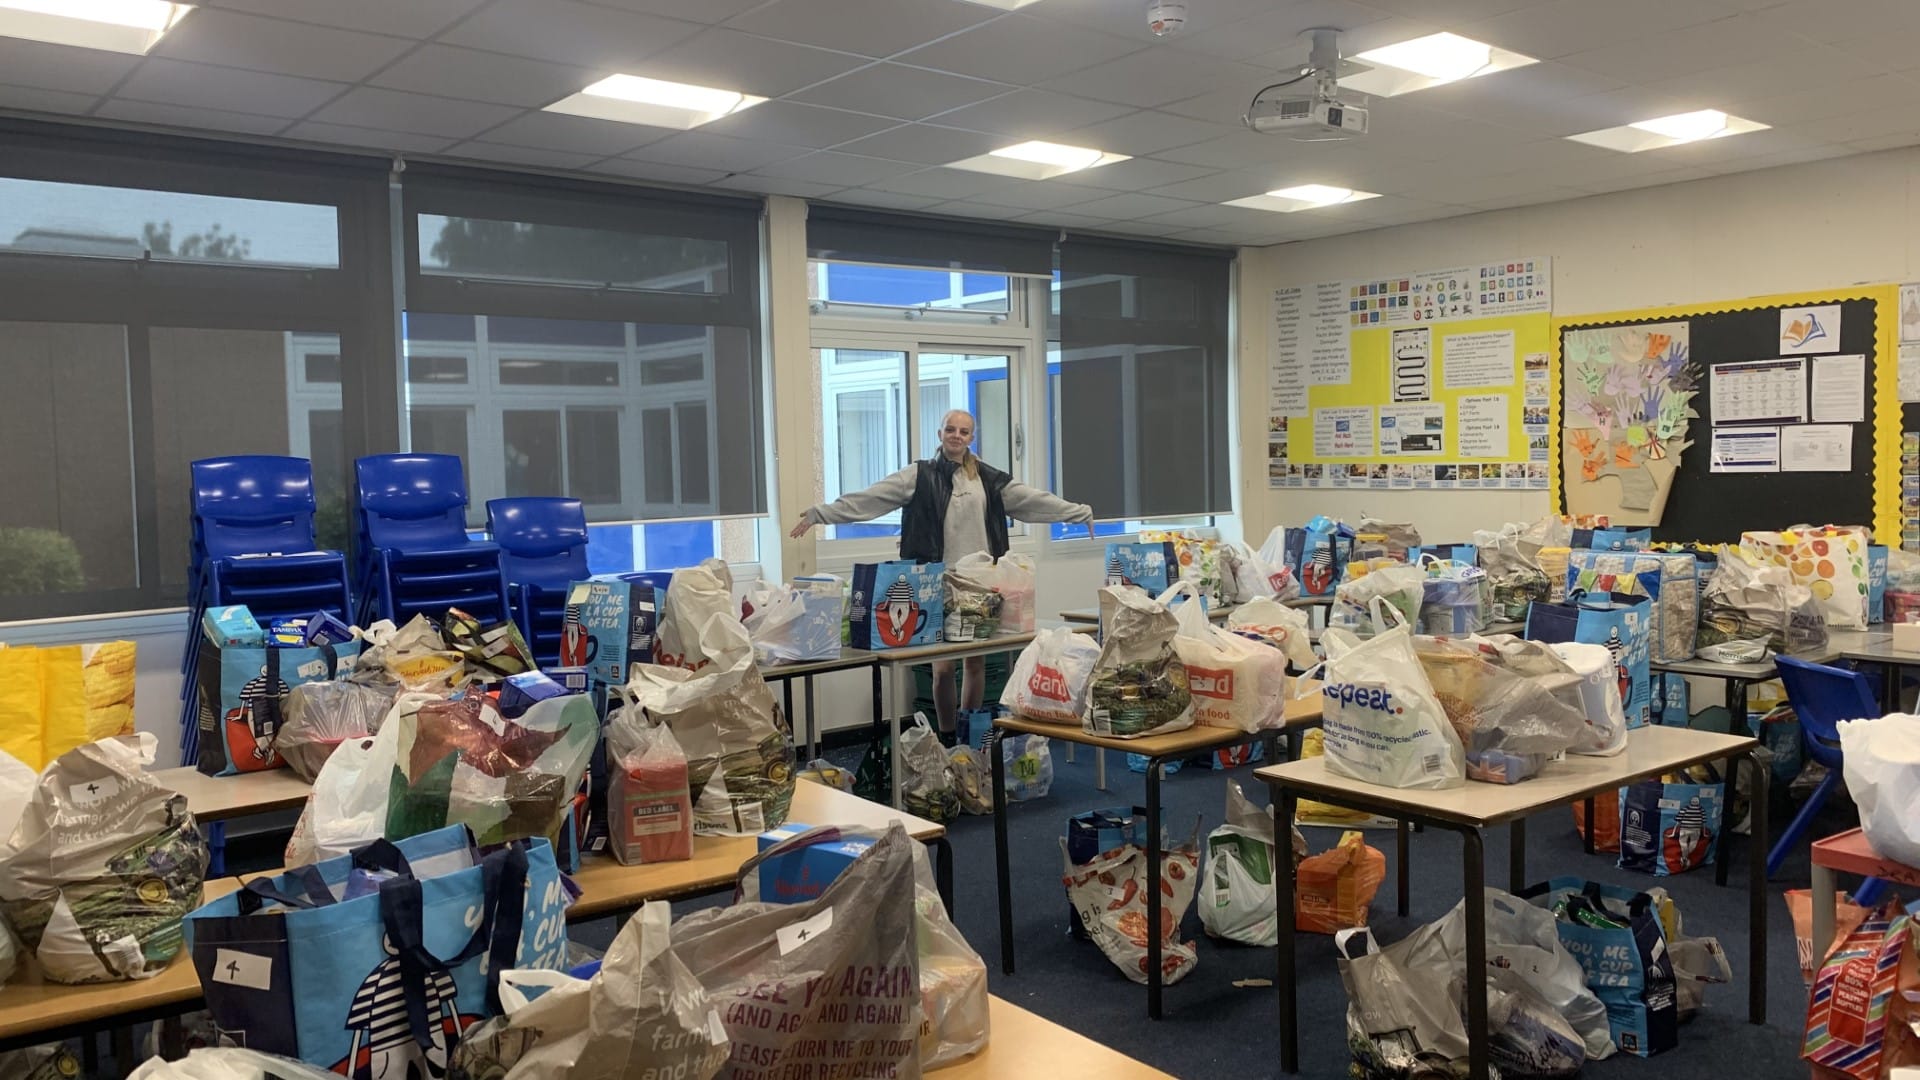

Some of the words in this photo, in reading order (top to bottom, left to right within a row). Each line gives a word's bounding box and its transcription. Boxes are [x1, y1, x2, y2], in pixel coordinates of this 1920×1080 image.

[602, 606, 624, 617] CUP
[271, 625, 304, 634] TAMPAX
[588, 618, 601, 629] OF
[1055, 708, 1077, 720] food
[1207, 707, 1230, 720] food
[1019, 759, 1035, 778] M
[638, 806, 652, 816] RED
[653, 804, 677, 815] LABEL
[1603, 945, 1629, 960] ME
[226, 960, 240, 981] 4
[1600, 960, 1633, 974] CUP
[1600, 971, 1630, 987] TEA
[726, 1003, 772, 1030] (AND
[817, 1002, 849, 1025] AND
[832, 1040, 856, 1059] ME
